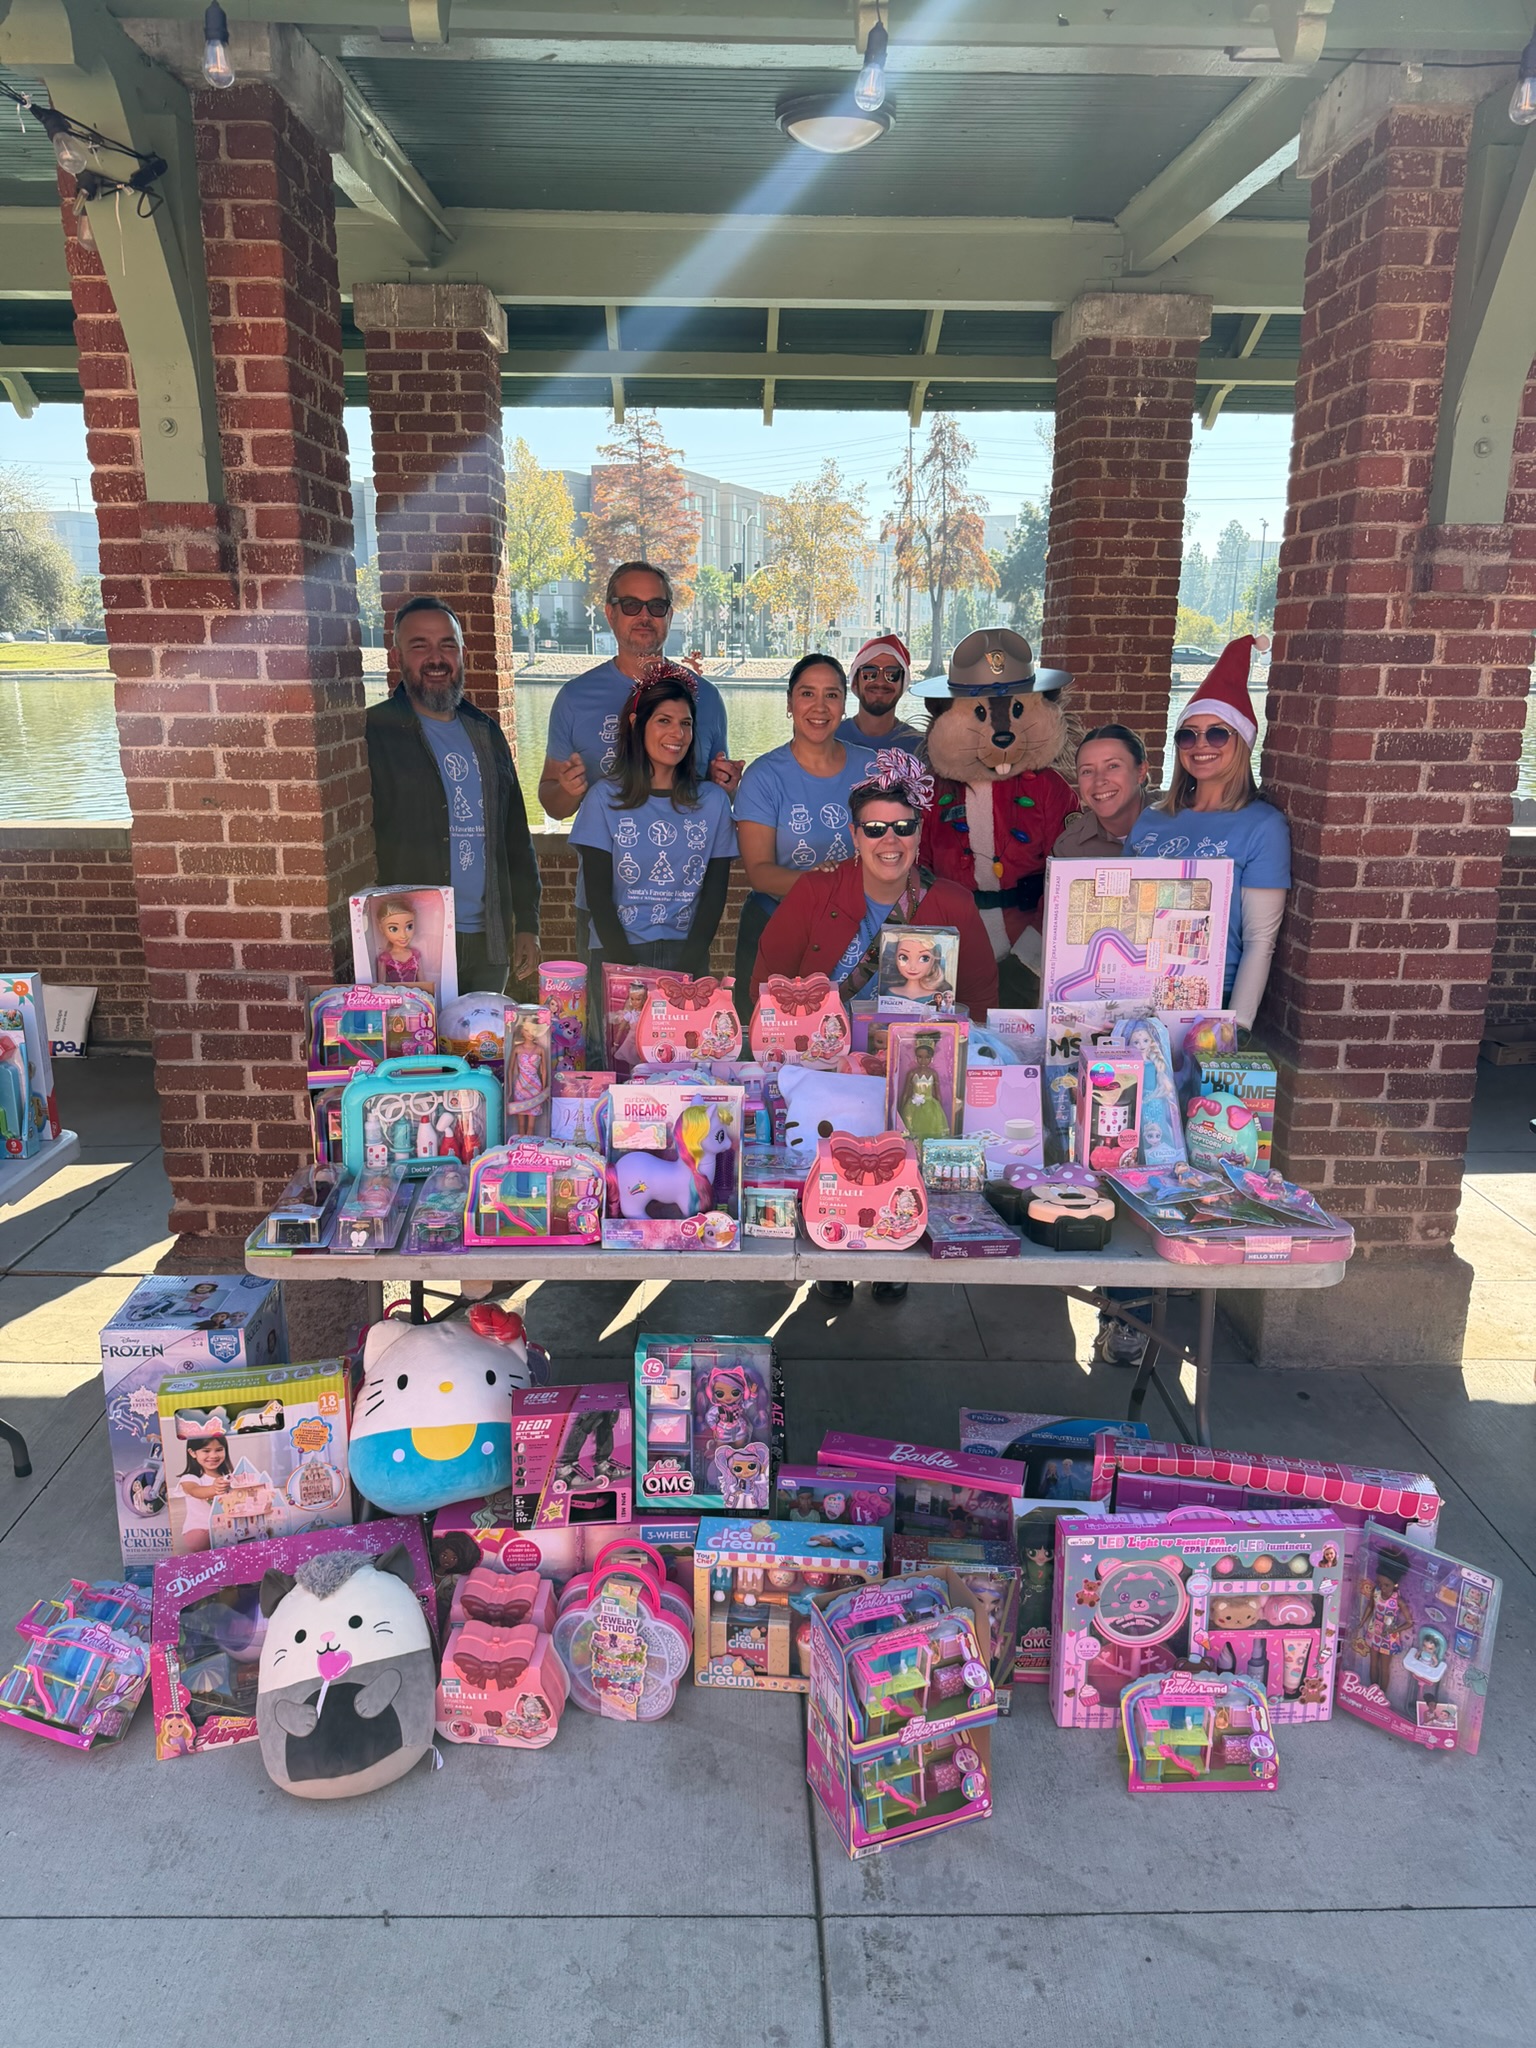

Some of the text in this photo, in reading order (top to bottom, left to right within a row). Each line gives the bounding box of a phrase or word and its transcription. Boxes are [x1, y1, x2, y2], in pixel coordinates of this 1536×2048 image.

[626, 888, 696, 898] Santa's Favorite Helper
[544, 978, 572, 992] Barbie
[1051, 1005, 1066, 1016] MS.
[54, 1009, 63, 1032] Envelope
[652, 1013, 690, 1022] PORTABLE
[1051, 1013, 1086, 1024] Rachel
[998, 1024, 1036, 1036] DREAMS
[50, 1040, 86, 1056] Fed
[1200, 1070, 1247, 1085] JUDY
[624, 1103, 668, 1118] DREAMS
[1190, 1134, 1222, 1148] PUPPYCORN
[411, 1166, 432, 1174] Doctor
[819, 1188, 864, 1197] PORTABLE
[120, 1336, 140, 1344] Disney
[101, 1344, 164, 1359] FROZEN
[646, 1363, 660, 1373] 15
[320, 1394, 338, 1408] 18
[771, 1402, 784, 1427] ACE
[971, 1414, 1005, 1424] FROZEN
[888, 1444, 958, 1469] Barbie
[968, 1447, 995, 1456] FROZEN
[1421, 1503, 1436, 1512] 3+
[647, 1531, 691, 1540] 3-WHEEL
[722, 1528, 752, 1541] Ice
[124, 1538, 174, 1548] CRUISE
[708, 1537, 776, 1552] Cream
[1098, 1536, 1126, 1549] LED
[1127, 1537, 1158, 1550] Light
[1161, 1539, 1174, 1548] up
[1175, 1538, 1206, 1547] Beauty
[1208, 1538, 1226, 1546] SPA
[1204, 1544, 1237, 1553] Beauté
[1239, 1540, 1265, 1552] LED
[1266, 1542, 1312, 1551] lumineux
[696, 1552, 710, 1561] Toy
[696, 1558, 714, 1566] Chef
[867, 1567, 879, 1575] 3+
[165, 1558, 228, 1598] Diana
[599, 1615, 639, 1627] JEWELRY
[602, 1624, 635, 1634] STUDIO
[734, 1633, 752, 1642] Ice
[728, 1639, 766, 1651] Cream
[708, 1662, 732, 1675] Ice
[698, 1672, 754, 1687] Cream
[1341, 1672, 1389, 1707] Barbie
[198, 1721, 259, 1745] Airpl
